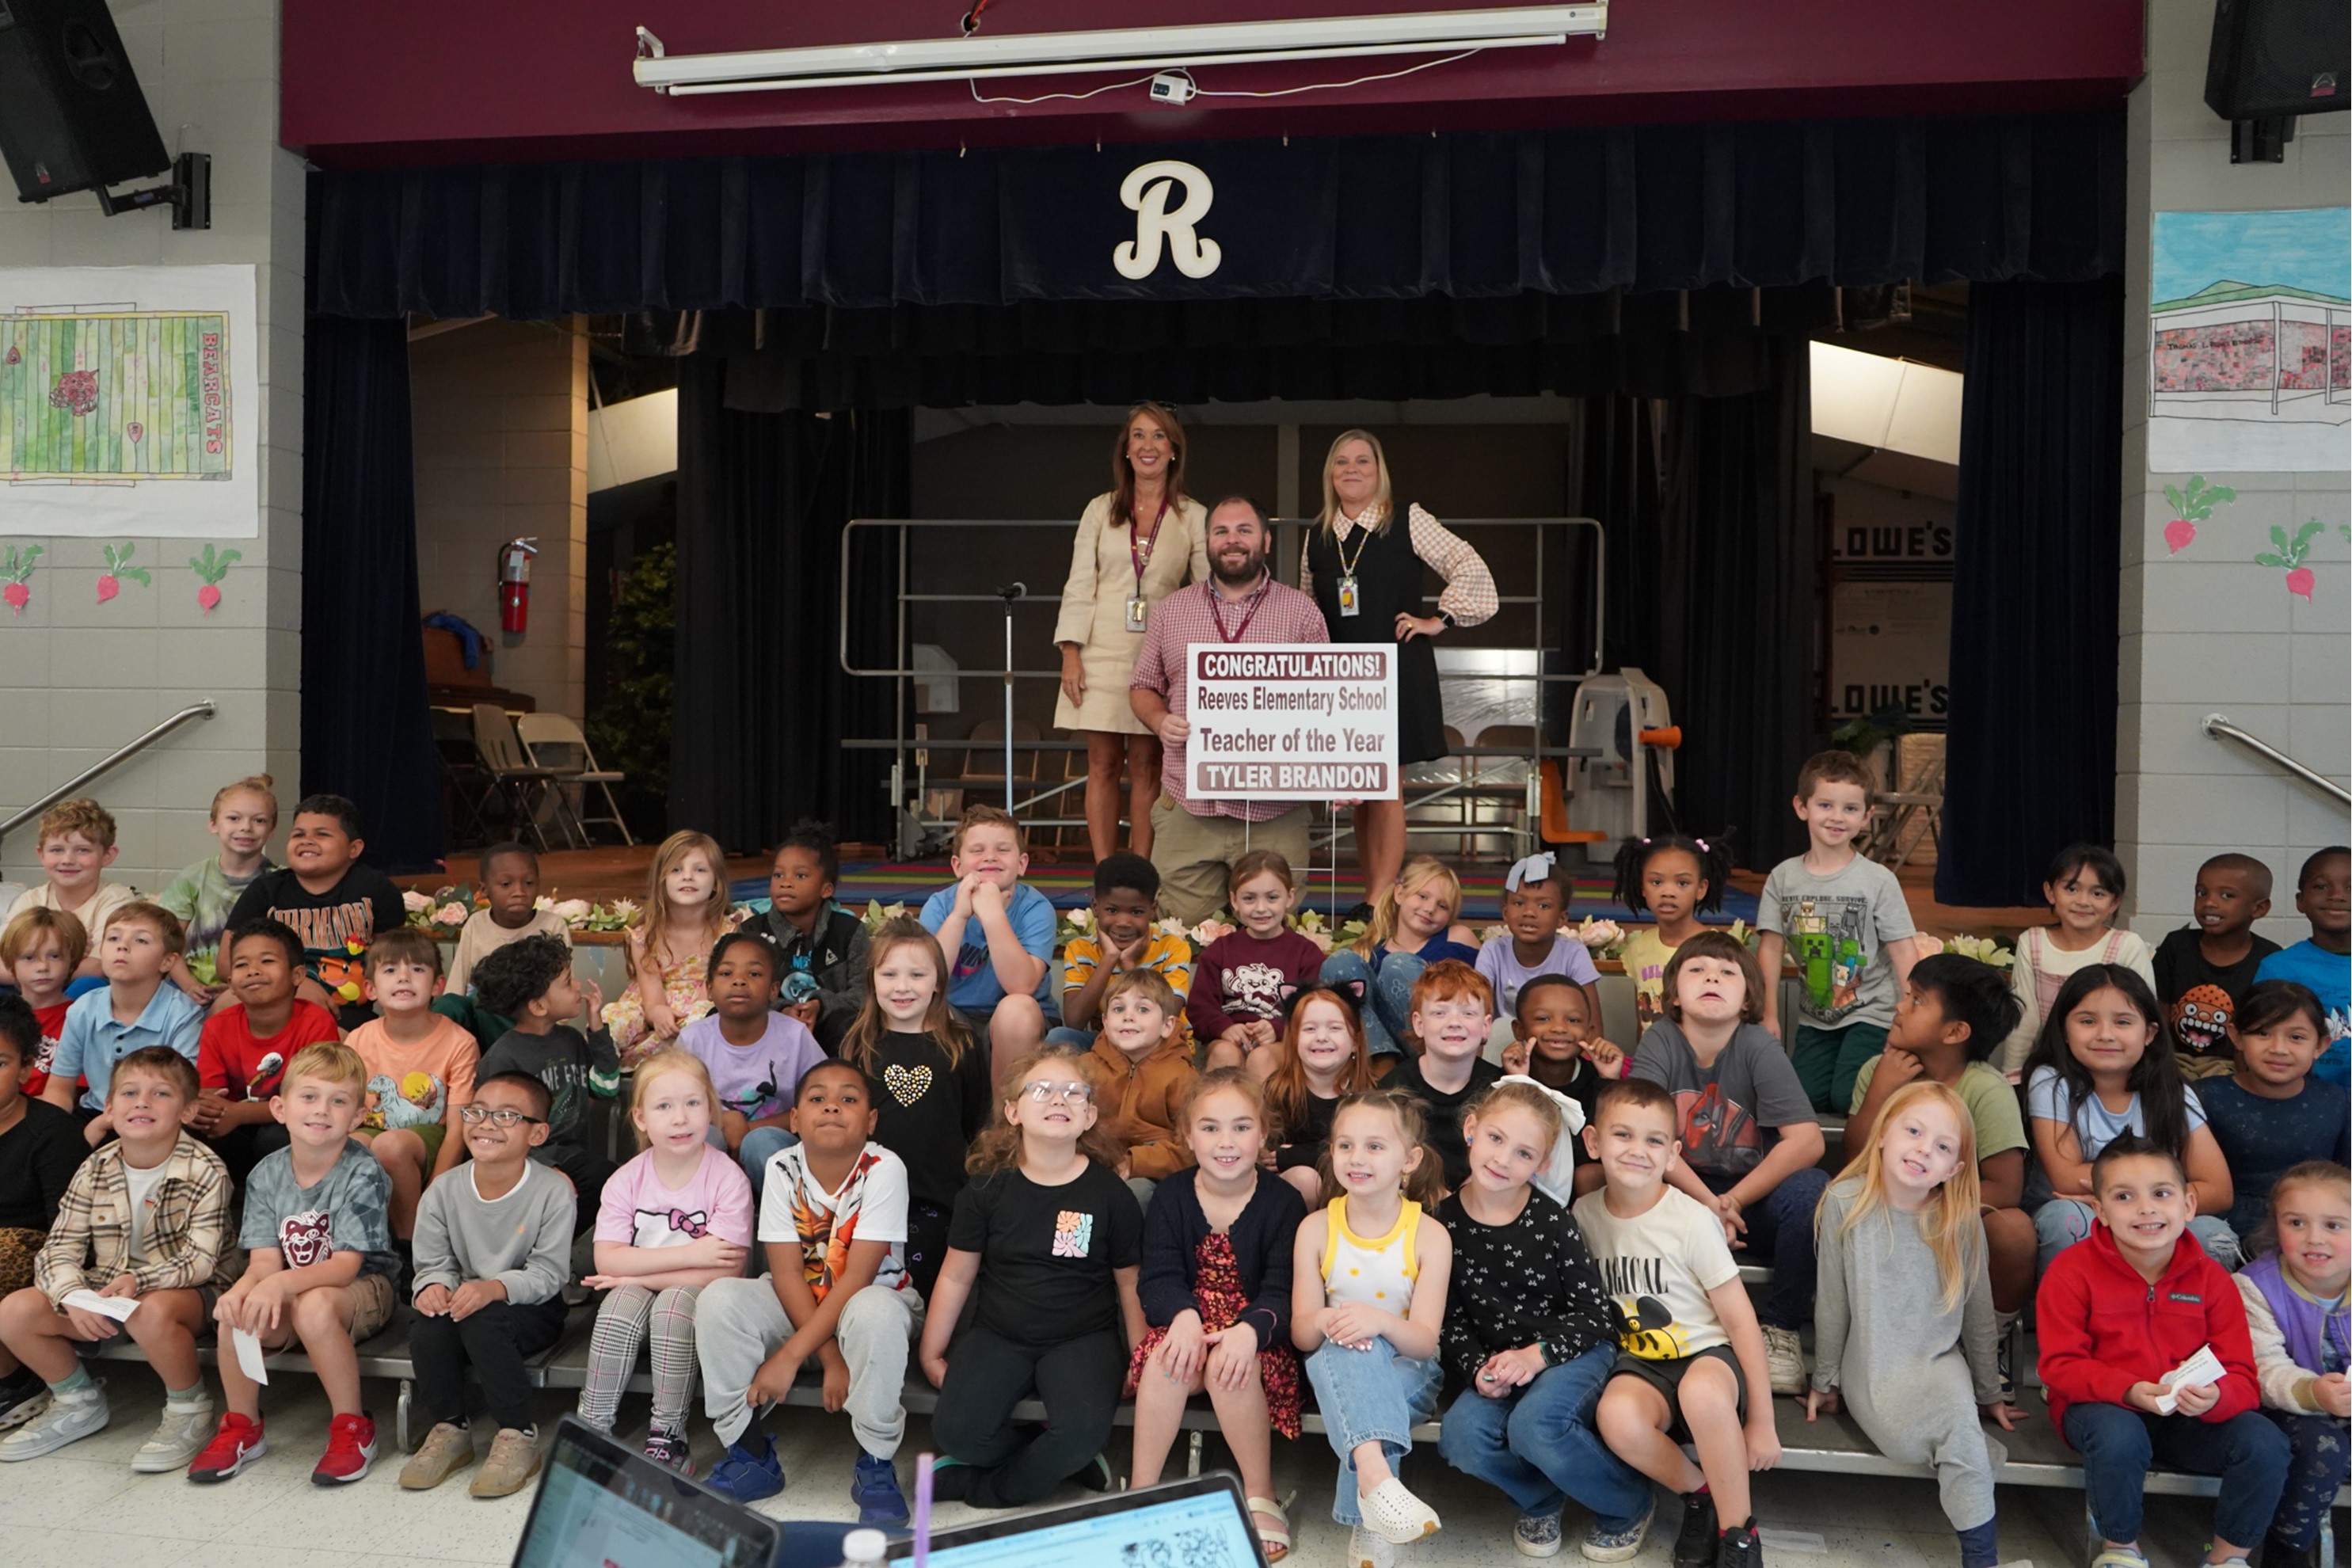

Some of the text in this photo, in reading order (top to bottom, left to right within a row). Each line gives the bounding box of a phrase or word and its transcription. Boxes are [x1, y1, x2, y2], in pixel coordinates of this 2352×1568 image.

[1113, 160, 1222, 280] R
[203, 333, 223, 455] BEARCATS
[1833, 520, 1952, 557] OWE'S
[1204, 654, 1380, 677] CONGRATULATIONS!
[1198, 686, 1387, 717] Reeves Elementary School
[1832, 678, 1949, 714] OWE'S
[1200, 727, 1384, 752] Teacher of the Year
[1206, 765, 1380, 788] TYLER BRANDON
[2175, 1293, 2201, 1303] Columbia
